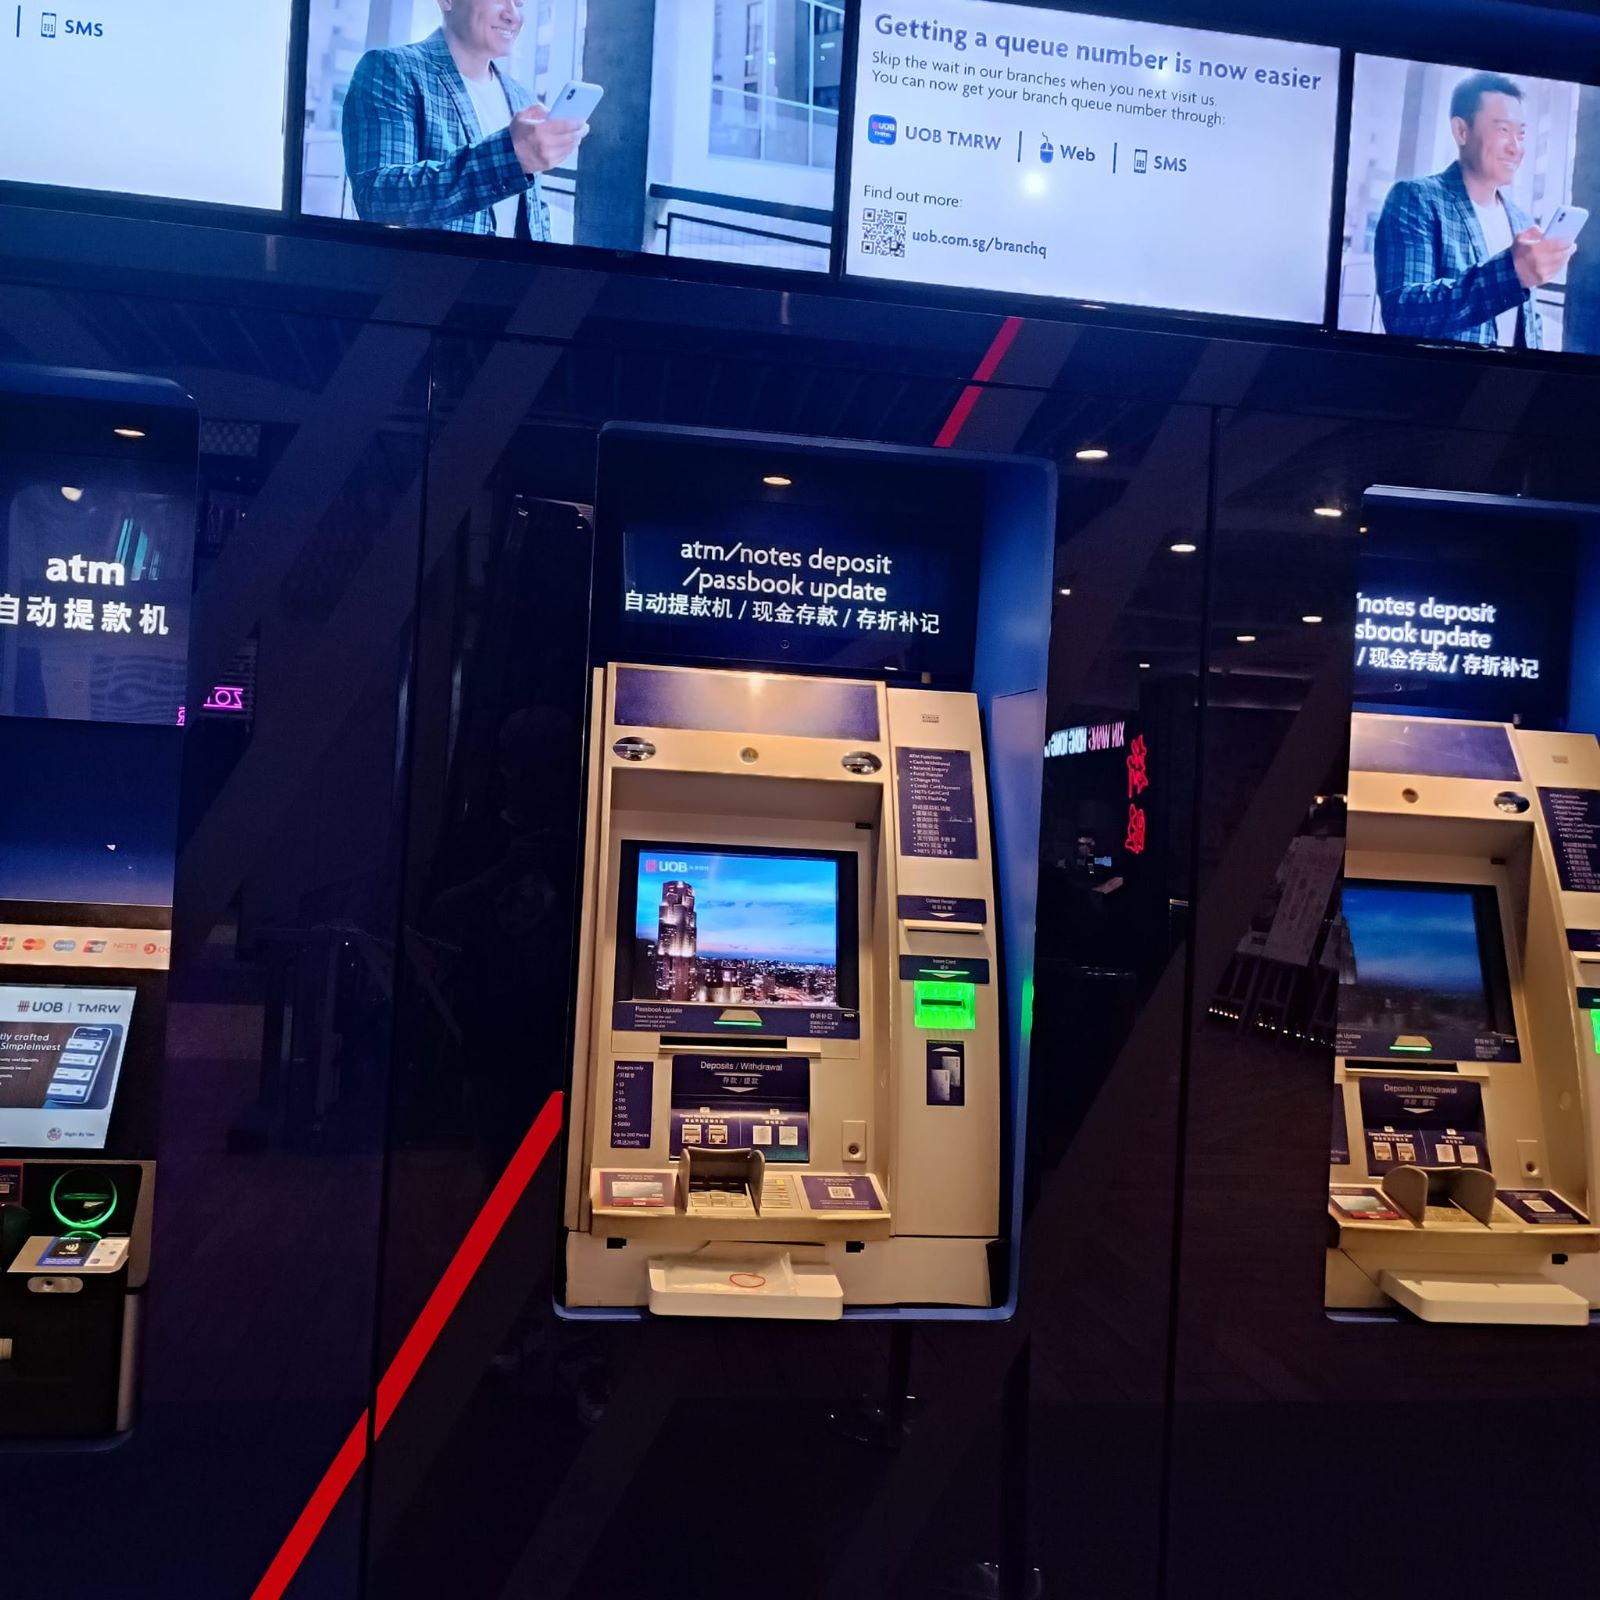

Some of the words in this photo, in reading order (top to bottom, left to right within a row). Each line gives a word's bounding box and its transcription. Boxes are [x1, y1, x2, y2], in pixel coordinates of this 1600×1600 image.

[64, 19, 104, 38] SMS
[875, 13, 968, 51] Getting
[975, 31, 988, 48] a
[995, 33, 1069, 58] queue
[1076, 44, 1168, 71] number
[1175, 52, 1192, 74] is
[1199, 60, 1248, 81] now
[1254, 67, 1322, 91] easier
[872, 51, 901, 70] Skip
[905, 54, 928, 70] the
[932, 58, 960, 75] wait
[964, 63, 976, 77] in
[979, 66, 1003, 80] our
[1006, 67, 1066, 88] branches
[1070, 74, 1106, 93] when
[1110, 81, 1134, 97] you
[1138, 86, 1167, 101] next
[1171, 88, 1197, 104] visit
[1201, 94, 1218, 106] us.
[872, 69, 898, 85] You
[902, 74, 925, 88] can
[929, 79, 958, 92] now
[962, 83, 983, 98] get
[987, 87, 1018, 101] your
[1022, 87, 1067, 106] branch
[1071, 96, 1112, 112] queue
[1116, 98, 1167, 119] number
[1172, 107, 1226, 128] through:
[905, 126, 942, 144] UOB
[947, 131, 1002, 151] TMRW
[1060, 144, 1096, 162] Web
[1153, 155, 1187, 173] SMS
[864, 184, 892, 200] Find
[896, 190, 919, 203] out
[924, 194, 963, 208] more:
[912, 229, 1047, 260] uob.com.sg/branchq
[45, 554, 125, 586] atm
[680, 541, 802, 568] atm/notes
[808, 548, 892, 577] deposit
[682, 567, 803, 596] /passbook
[810, 577, 887, 604] update
[0, 594, 169, 635] 自动提款机
[624, 589, 733, 619] 自动提款机
[752, 601, 839, 628] 现金存款
[856, 607, 940, 634] 存折补记
[1419, 597, 1497, 625] deposit
[1421, 626, 1492, 650] update
[1369, 647, 1448, 673] 现金存款
[1462, 653, 1540, 679] 存折补记
[659, 860, 688, 873] UOB
[32, 1001, 63, 1013] UOB
[77, 1003, 122, 1014] TMRW
[0, 1042, 61, 1051] SimpleInvest
[14, 1033, 50, 1042] crafted
[700, 1061, 734, 1072] Deposits
[740, 1062, 783, 1072] Withdrawal
[1420, 1085, 1457, 1094] Withdrawal
